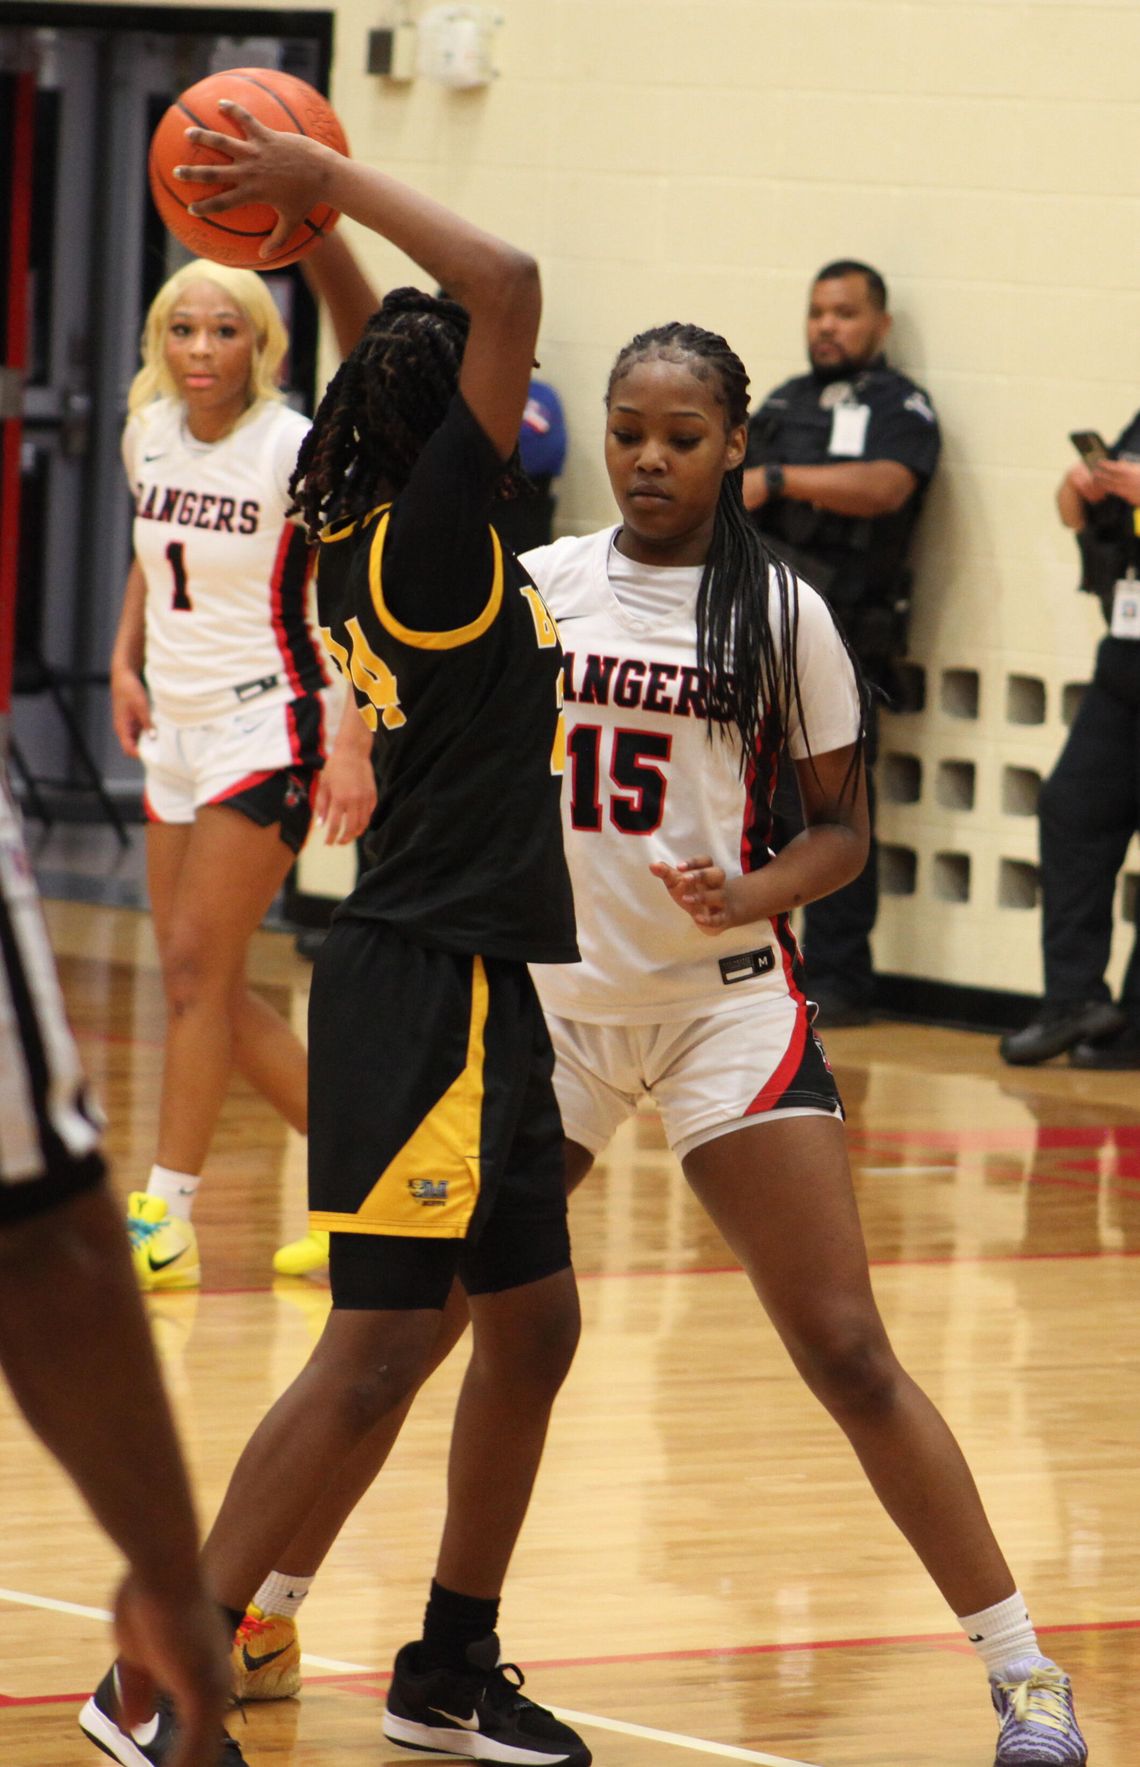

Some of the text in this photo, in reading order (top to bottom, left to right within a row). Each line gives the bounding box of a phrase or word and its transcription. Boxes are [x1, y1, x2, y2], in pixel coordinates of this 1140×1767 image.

[136, 481, 260, 535] ANGERS
[166, 541, 192, 612] 1
[567, 723, 673, 836] 15
